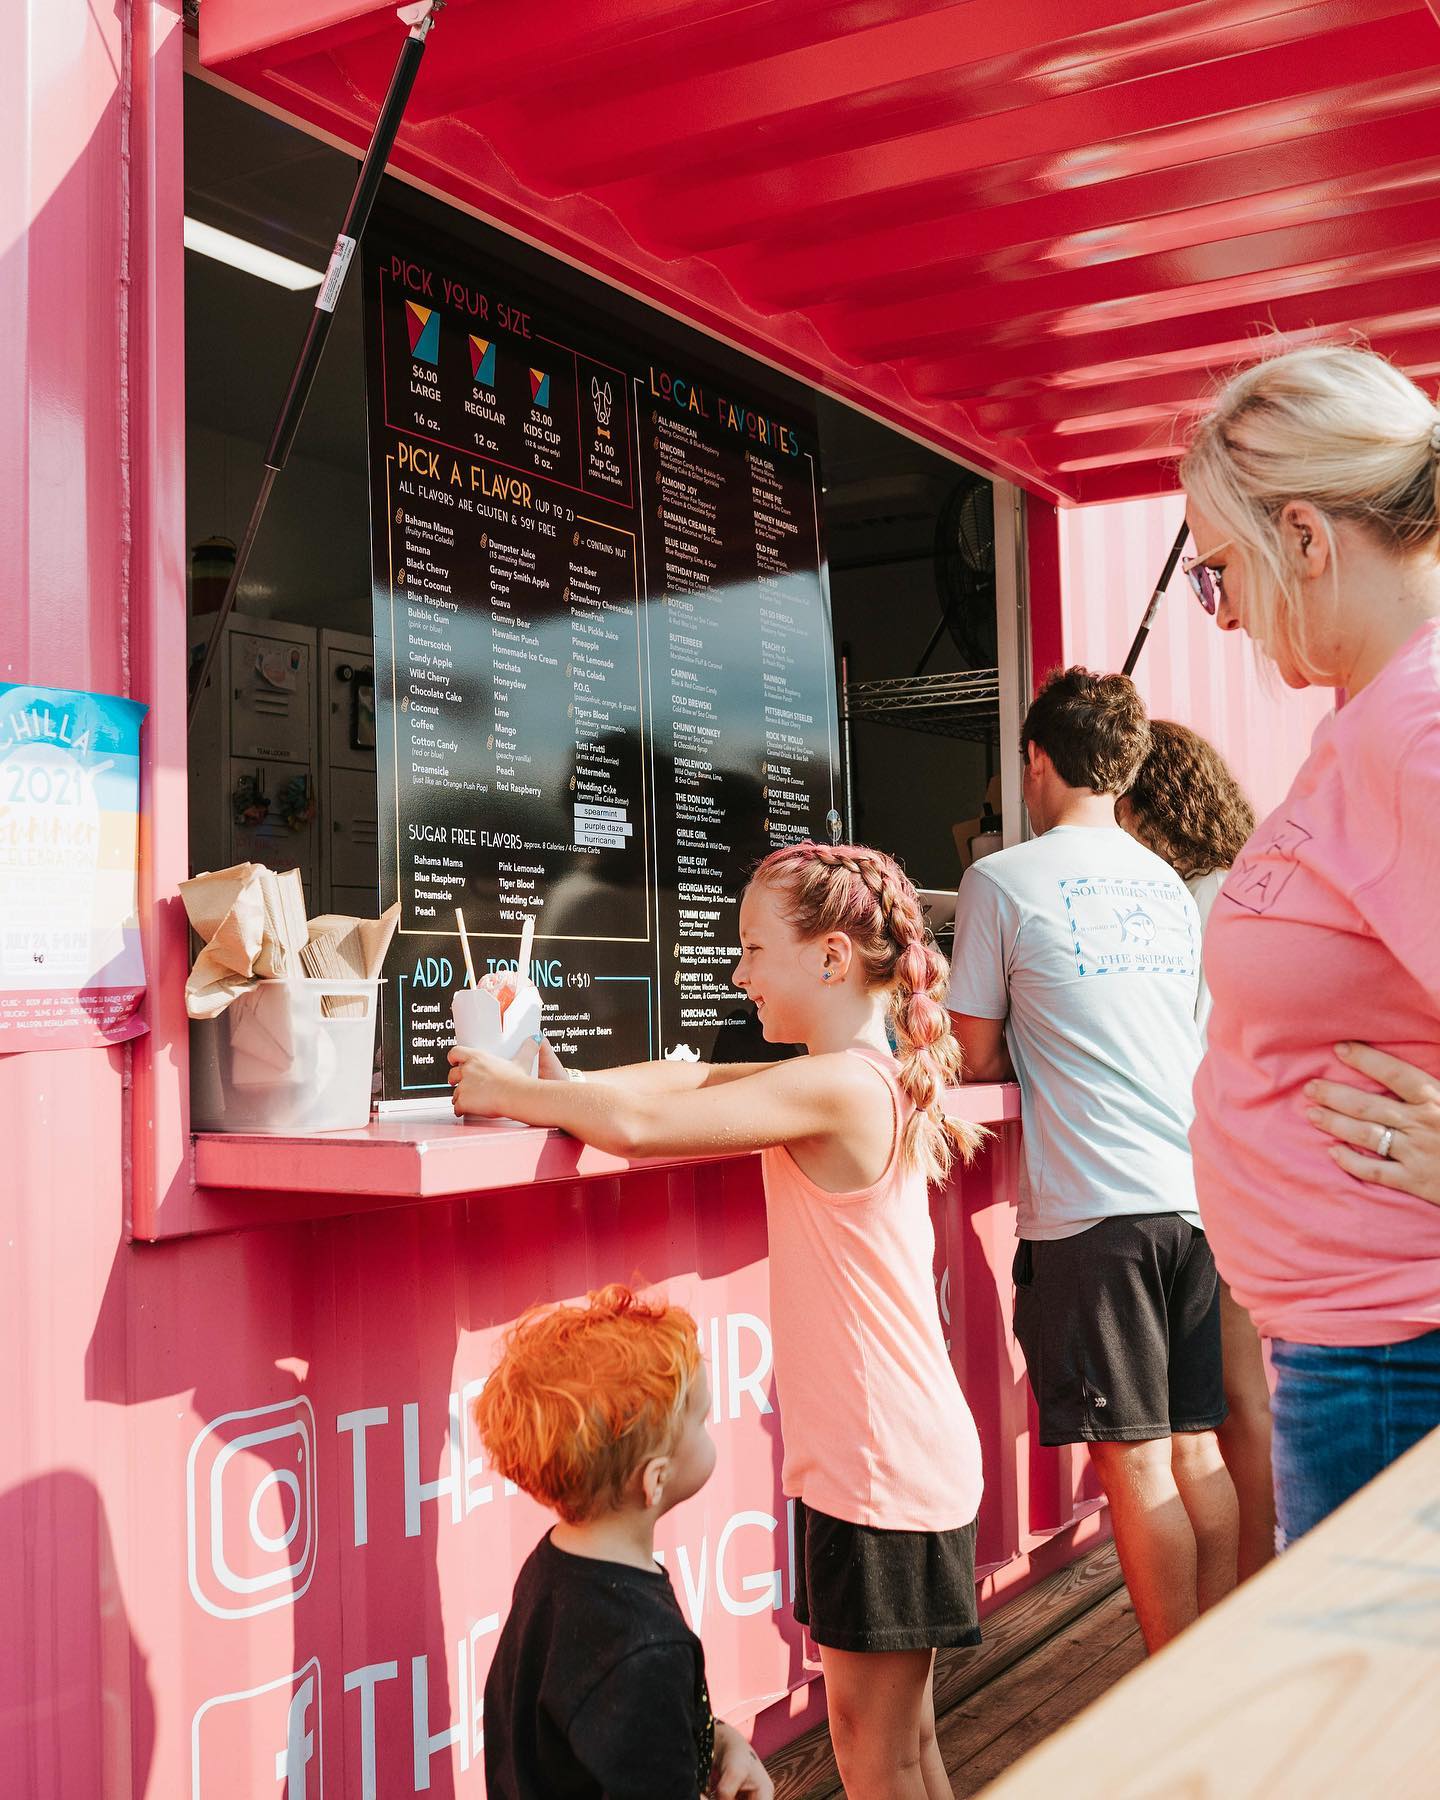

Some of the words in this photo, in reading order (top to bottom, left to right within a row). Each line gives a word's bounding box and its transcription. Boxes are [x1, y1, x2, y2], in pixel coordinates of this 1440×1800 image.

[391, 255, 433, 297] PICK
[443, 278, 488, 321] YOUR
[497, 303, 532, 340] SIZE
[412, 364, 438, 384] $6.00
[410, 381, 441, 402] LARGE
[473, 387, 497, 406] $4.00
[464, 401, 506, 426] REGULAR
[530, 409, 553, 427] $3.00
[650, 366, 709, 418] LOCAL
[718, 398, 799, 457] FAVORITES
[413, 411, 425, 426] 16
[427, 418, 441, 431] oz.
[523, 422, 543, 442] KIDS
[544, 428, 561, 446] CUP
[473, 433, 485, 446] 12
[487, 439, 499, 451] oz.
[594, 441, 615, 457] $1.00
[534, 454, 539, 465] 8
[541, 458, 553, 470] oz.
[590, 454, 605, 469] Pup
[607, 461, 620, 475] Cup
[398, 441, 440, 481] PICK
[450, 461, 462, 487] A
[471, 465, 532, 509] FLAVOR
[536, 497, 550, 515] (UP
[553, 504, 563, 519] TO
[565, 508, 575, 523] 2)
[662, 476, 687, 492] ALMOND
[687, 485, 698, 496] JOY
[399, 481, 415, 496] ALL
[418, 485, 455, 507] FLAVORS
[458, 498, 473, 512] ARE
[477, 503, 509, 523] GLUTEN
[511, 515, 518, 526] &
[521, 517, 535, 531] SOY
[538, 522, 557, 538] FREE
[405, 514, 432, 530] Bahama
[433, 522, 454, 536] Mama
[663, 510, 688, 526] BANANA
[688, 519, 707, 533] CREAM
[708, 525, 717, 536] PIE
[406, 541, 431, 556] Banana
[489, 539, 520, 556] Dumpster
[521, 547, 536, 561] Juice
[587, 539, 614, 555] CONTAINS
[615, 547, 627, 559] NUT
[756, 543, 767, 553] OLD
[767, 547, 779, 558] FART
[406, 557, 425, 571] Black
[426, 562, 449, 579] Cherry
[666, 562, 693, 578] BIRTHDAY
[693, 571, 710, 584] PARTY
[407, 574, 422, 586] Blue
[424, 578, 452, 594] Coconut
[490, 565, 513, 581] Granny
[514, 571, 531, 584] Smith
[532, 575, 550, 590] Apple
[490, 581, 510, 595] Grape
[569, 577, 601, 595] Strawberry
[407, 591, 423, 603] Blue
[424, 595, 459, 613] Raspberry
[491, 596, 511, 609] Guava
[570, 592, 602, 609] Strawberry
[602, 601, 634, 616] Cheesecake
[408, 607, 432, 622] Bubble
[433, 614, 450, 625] Gum
[492, 612, 516, 627] Gummy
[517, 618, 531, 630] Bear
[409, 635, 452, 652] Butterscotch
[409, 651, 431, 666] Candy
[432, 655, 453, 669] Apple
[492, 644, 528, 660] Homemade
[529, 651, 538, 662] Ice
[538, 654, 558, 666] Cream
[493, 660, 522, 674] Horchata
[410, 668, 426, 680] Wild
[427, 671, 450, 686] Cherry
[671, 668, 699, 682] CARNIVAL
[493, 675, 527, 691] Honeydew
[410, 685, 445, 699] Chocolate
[446, 691, 463, 703] Cake
[493, 691, 509, 703] Kiwi
[411, 702, 440, 715] Coconut
[494, 707, 510, 719] Lime
[574, 707, 592, 719] Tigers
[593, 710, 609, 721] Blood
[411, 718, 435, 731] Coffee
[495, 723, 517, 737] Mango
[673, 721, 697, 734] CHUNKY
[697, 727, 721, 738] MONKEY
[412, 735, 436, 748] Cotton
[437, 739, 459, 753] Candy
[495, 739, 517, 751] Nectar
[412, 763, 450, 777] Dreamsicle
[496, 765, 515, 777] Peach
[674, 757, 713, 771] DINGLEWOOD
[768, 764, 780, 774] ROLL
[781, 766, 792, 776] TIDE
[576, 766, 611, 779] Watermelon
[496, 781, 510, 792] Red
[510, 783, 542, 798] Raspberry
[576, 781, 603, 795] Wedding
[603, 783, 617, 795] Cake
[675, 793, 687, 803] THE
[687, 794, 701, 805] DON
[701, 796, 715, 807] DON
[768, 789, 782, 798] ROOT
[783, 791, 795, 801] BEER
[795, 793, 810, 803] FLOAT
[584, 807, 618, 819] spearmint
[584, 822, 607, 832] purple
[607, 824, 624, 833] daze
[769, 822, 787, 832] SALTED
[788, 825, 811, 835] CARAMEL
[408, 824, 447, 843] SUGAR
[451, 828, 477, 846] FREE
[481, 831, 523, 850] FLAVORS
[584, 836, 617, 846] hurricane
[414, 855, 442, 867] Bahama
[443, 857, 464, 868] Mama
[498, 862, 513, 872] Pink
[514, 863, 546, 875] Lemonade
[678, 856, 695, 866] GIRLIE
[696, 857, 708, 866] GUY
[414, 872, 431, 883] Blue
[431, 873, 466, 888] Raspberry
[498, 878, 516, 890] Tiger
[517, 879, 535, 890] Blood
[415, 889, 453, 902] Dreamsicle
[678, 882, 704, 893] GEORGIA
[704, 885, 723, 894] PEACH
[1071, 886, 1147, 898] SOUTHERN
[499, 894, 528, 907] Wedding
[528, 896, 544, 906] Cake
[415, 906, 436, 917] Peach
[500, 910, 515, 921] Wild
[1098, 954, 1132, 965] THE
[412, 957, 453, 988] ADD
[486, 958, 563, 988] TOPING
[567, 973, 591, 989] (+$1)
[411, 1002, 441, 1014] Caramel
[412, 1020, 445, 1031] Hersheys
[543, 1028, 566, 1039] Gummy
[566, 1027, 588, 1038] Spiders
[589, 1029, 596, 1037] or
[596, 1027, 613, 1037] Bears
[412, 1037, 436, 1048] Glitter
[561, 1043, 578, 1054] Rings
[412, 1054, 435, 1065] Nerds
